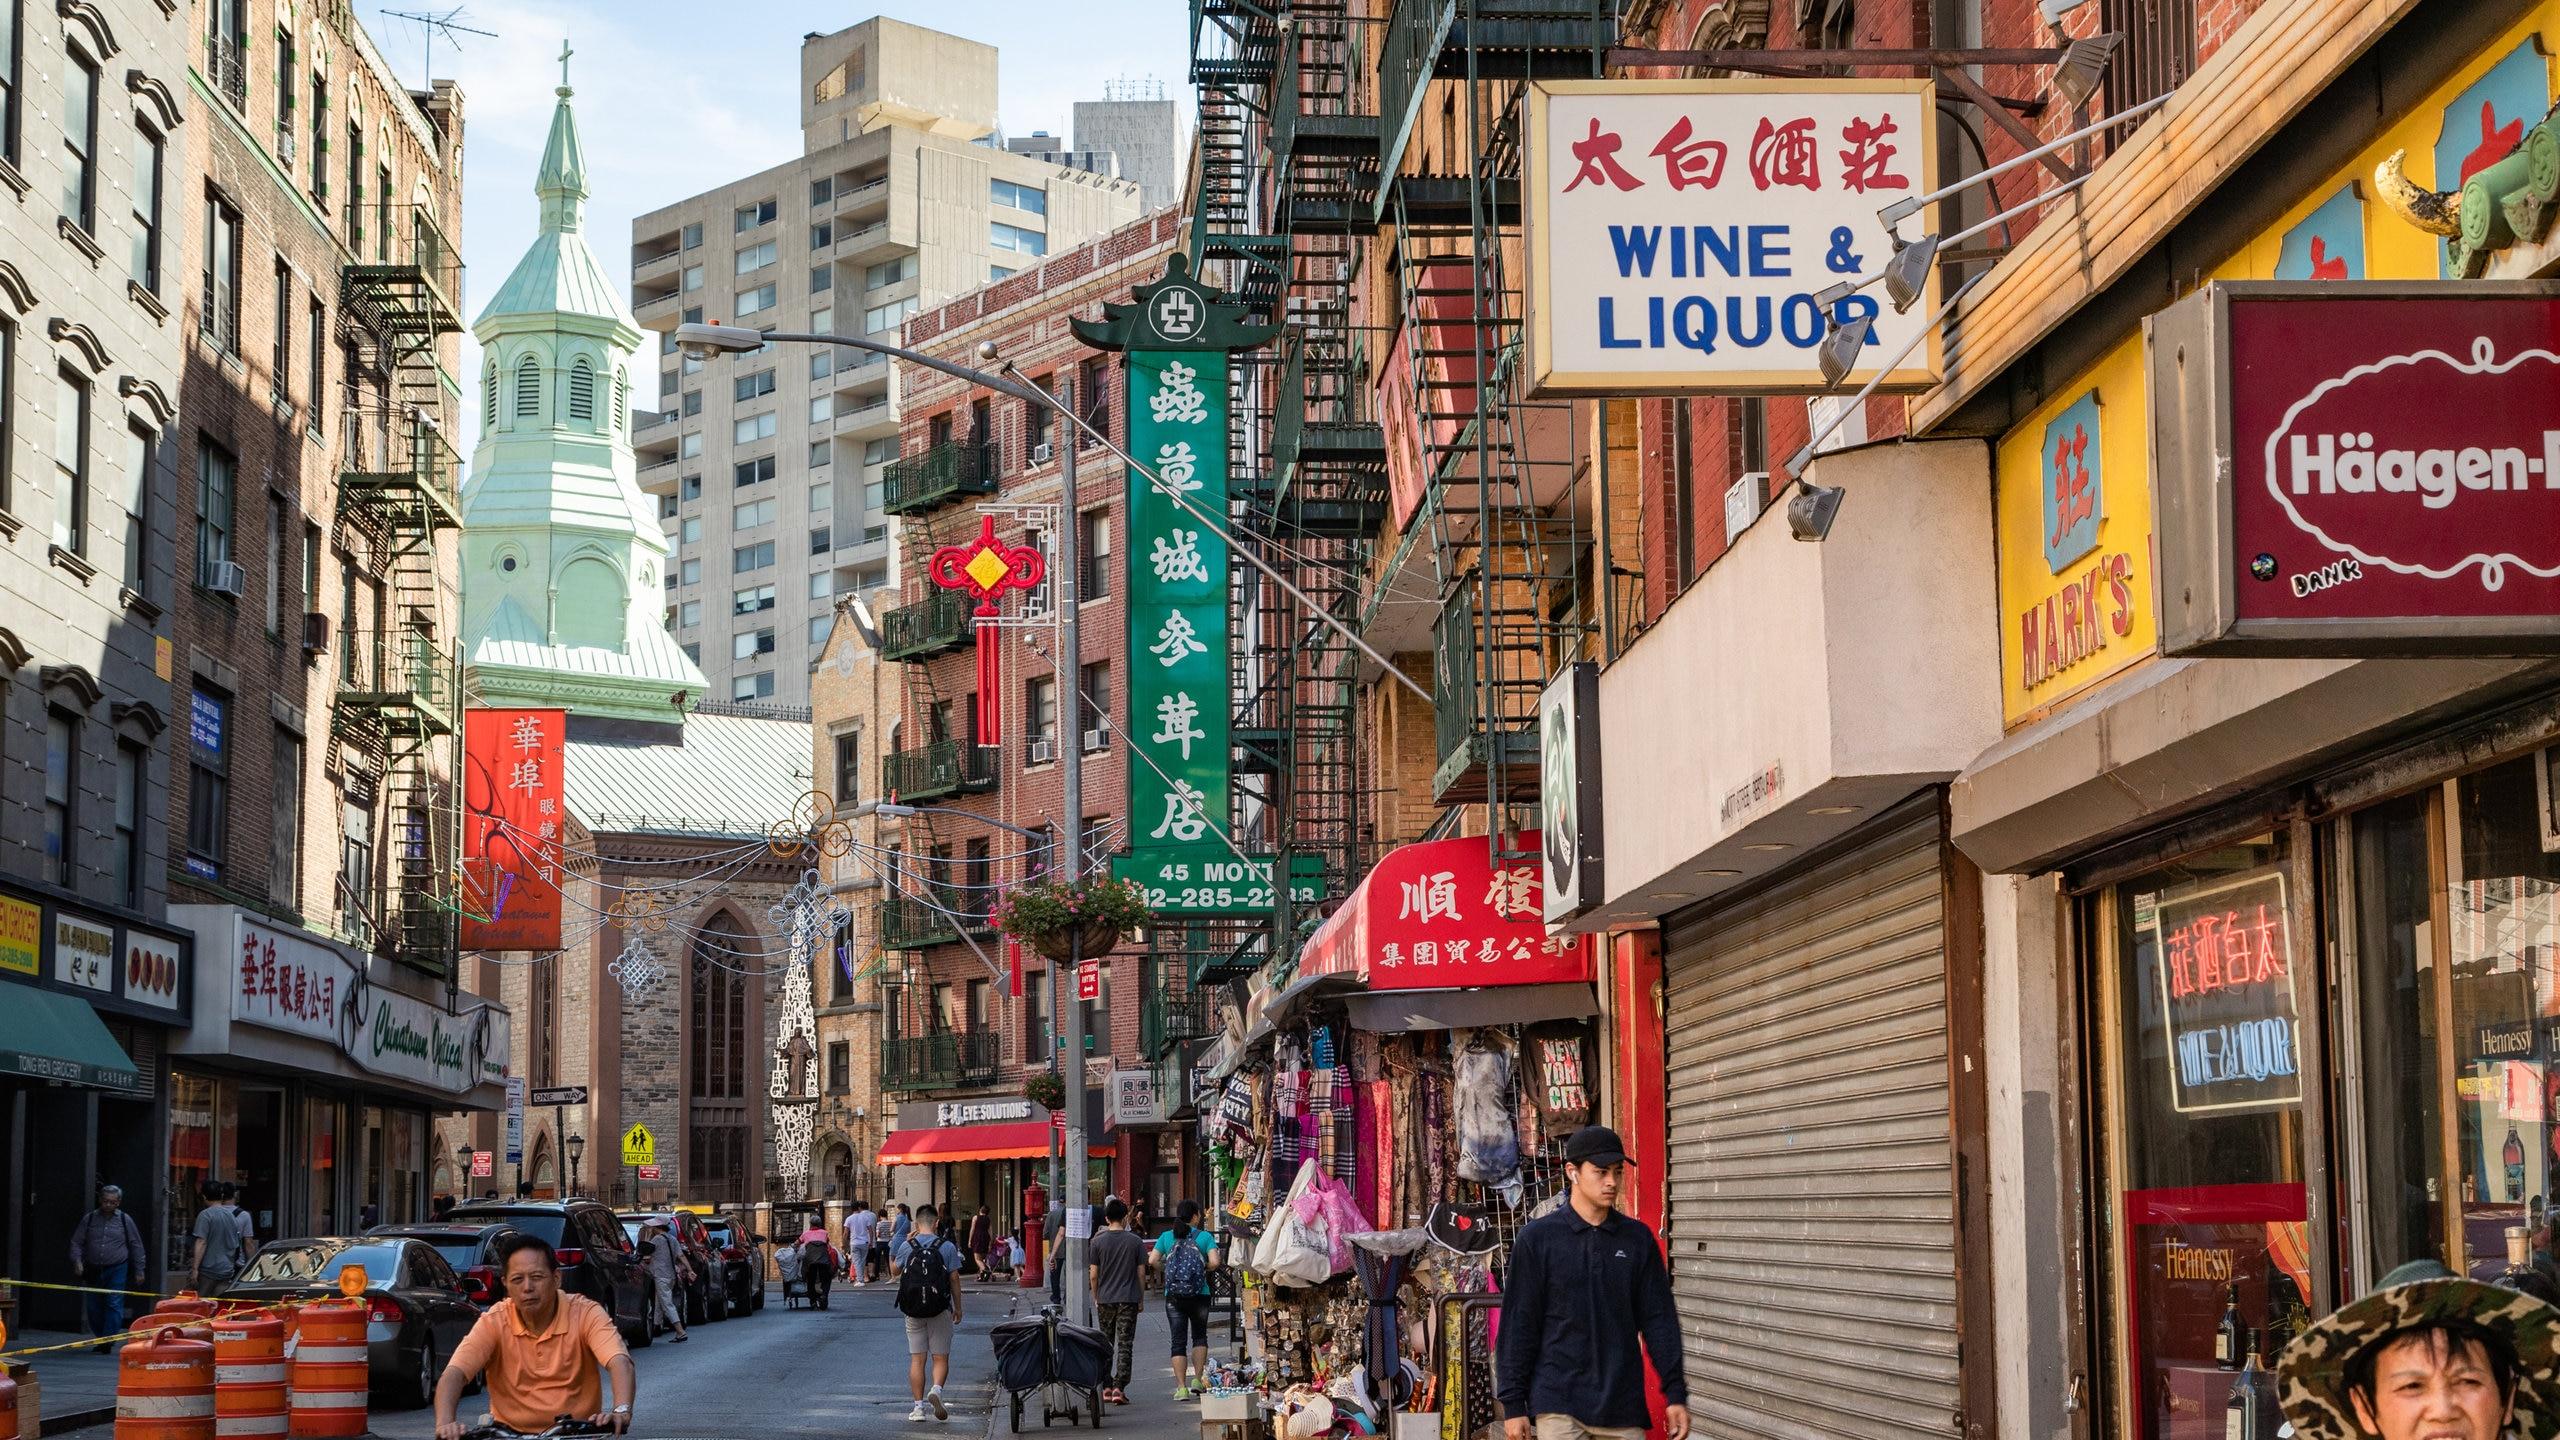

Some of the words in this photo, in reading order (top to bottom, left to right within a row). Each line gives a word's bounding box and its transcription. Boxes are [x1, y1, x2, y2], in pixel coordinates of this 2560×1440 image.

[1562, 112, 1909, 195] 太白酒莊
[1607, 224, 1792, 278] WINE
[1825, 225, 1863, 274] &
[2291, 558, 2362, 597] DANK
[2021, 552, 2135, 690] MARK'S
[508, 715, 545, 799] 華埠
[538, 798, 557, 884] 眼鏡公司
[1159, 863, 1189, 881] 45
[1203, 862, 1274, 882] MOTT
[1379, 936, 1564, 969] 集團貿易公司
[241, 931, 335, 1029] 華埠眼鏡公司
[373, 1000, 428, 1061] Chinatown
[431, 1016, 465, 1078] Optical
[1542, 1038, 1581, 1063] NEW
[2481, 1029, 2533, 1056] Hennessy
[18, 1055, 37, 1072] TONG
[37, 1058, 50, 1074] REN
[51, 1060, 82, 1081] GROCERY
[1543, 1061, 1583, 1086] YORK
[535, 1092, 554, 1102] ONE
[563, 1091, 582, 1101] WAY
[963, 1104, 979, 1122] EYE
[980, 1101, 1028, 1120] SOLUTIONS
[1549, 1084, 1589, 1110] CITY
[625, 1153, 651, 1164] AHEAD
[2166, 1237, 2235, 1290] Hennessy
